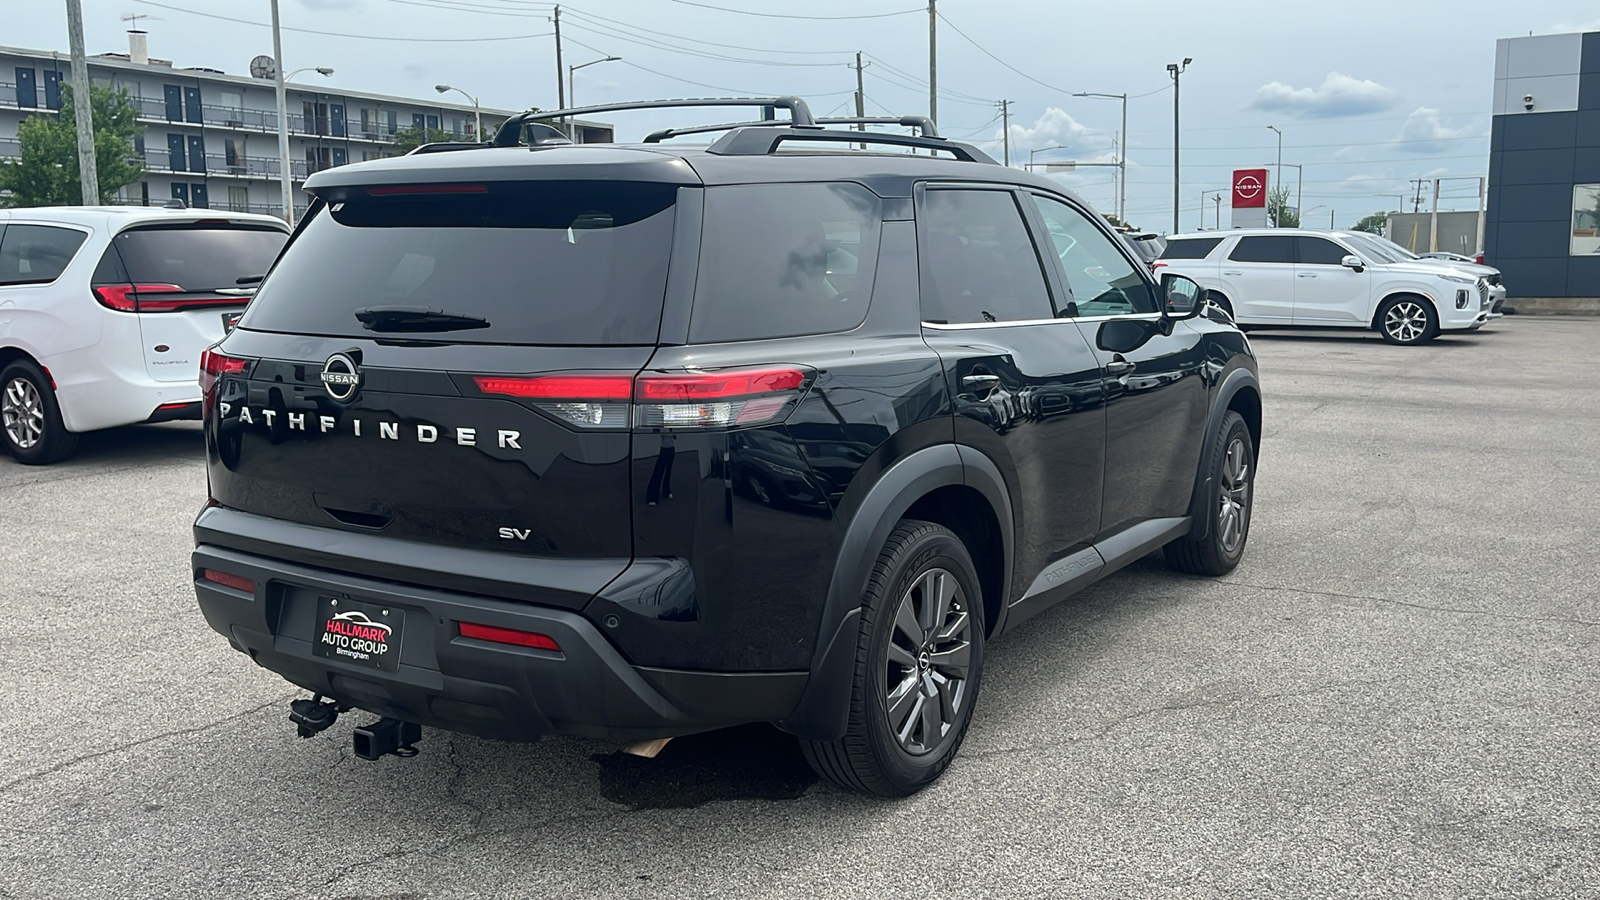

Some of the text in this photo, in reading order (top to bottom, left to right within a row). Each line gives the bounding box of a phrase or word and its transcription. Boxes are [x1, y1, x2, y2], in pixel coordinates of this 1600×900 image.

[321, 372, 359, 385] NISSAN
[219, 402, 522, 449] PATHFINDER
[498, 527, 532, 541] SV
[1044, 552, 1100, 583] PATHFINDER
[326, 620, 386, 642] HALLMARK
[321, 632, 388, 655] AUTO GROUP
[336, 647, 370, 660] Birmingham
